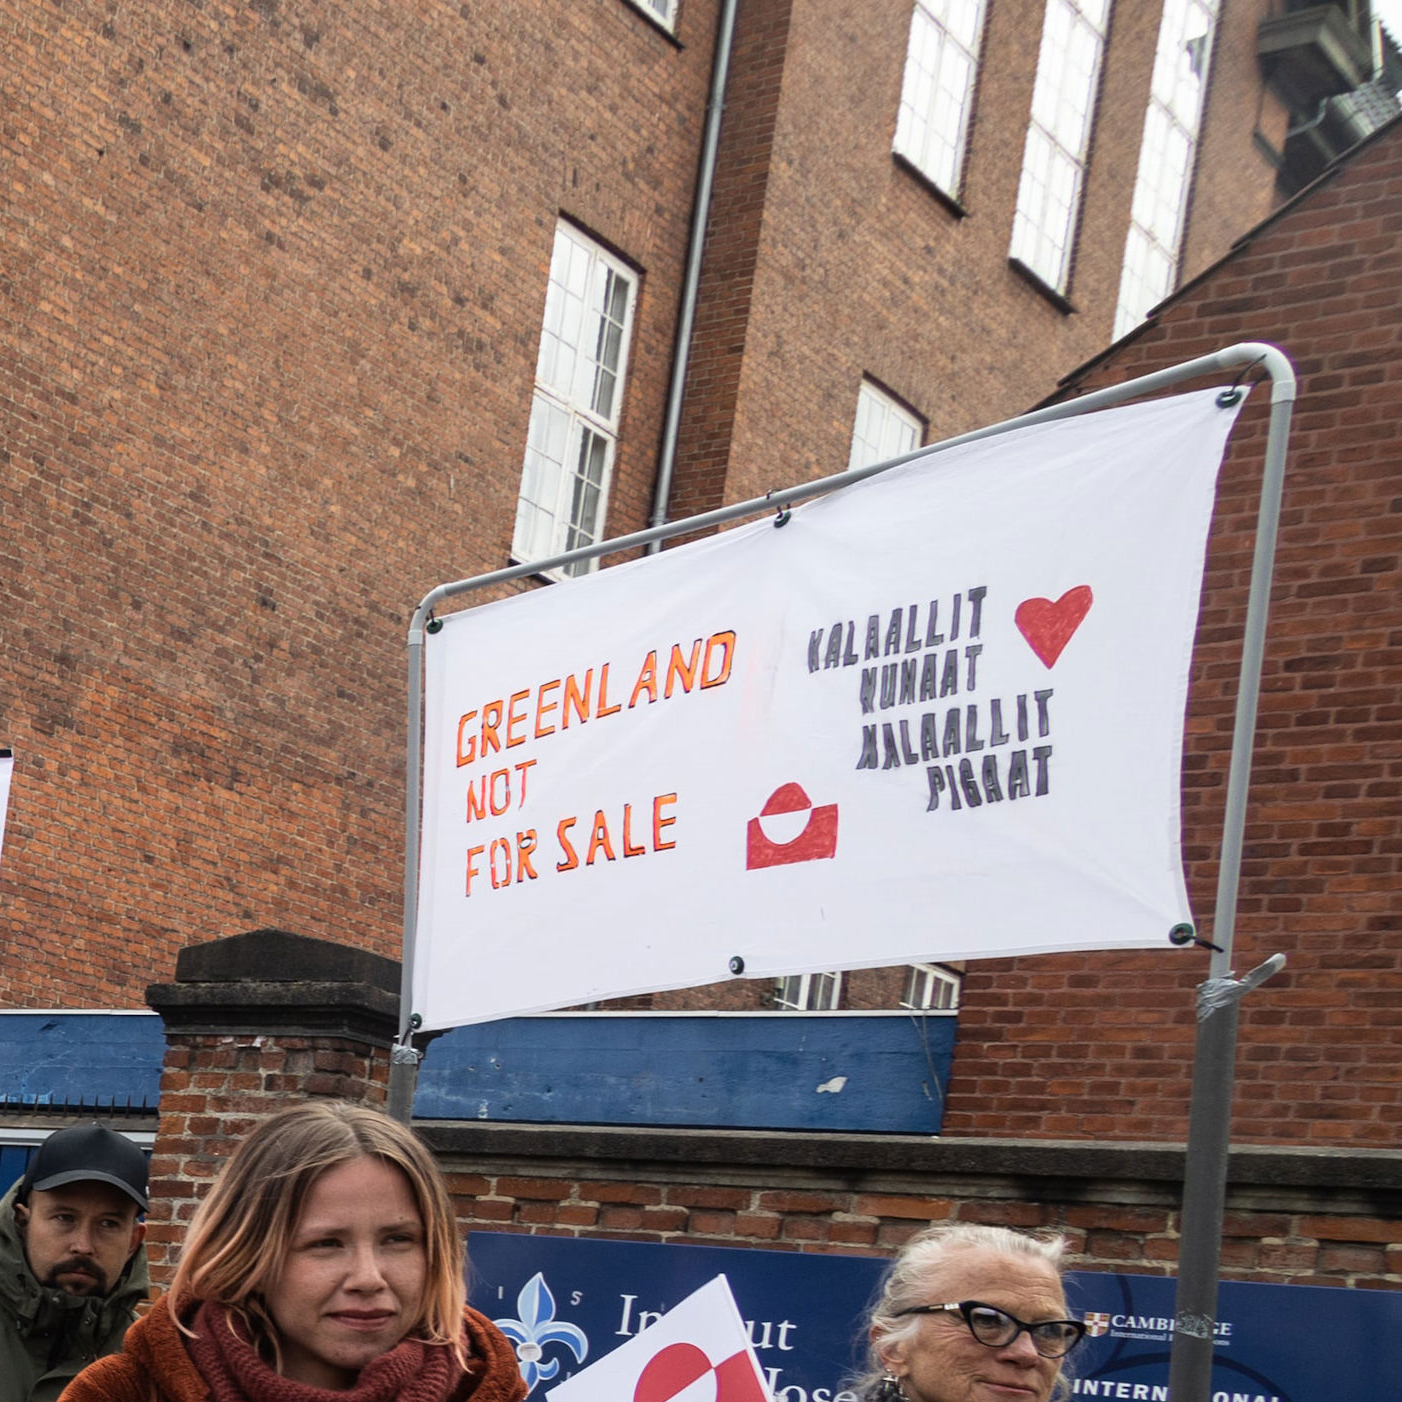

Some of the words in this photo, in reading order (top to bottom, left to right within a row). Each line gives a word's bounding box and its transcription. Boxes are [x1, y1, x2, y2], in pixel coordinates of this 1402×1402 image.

[807, 585, 987, 674] KALAALLIT
[455, 629, 738, 770] GREENLAND
[465, 758, 538, 825] NOT
[464, 831, 539, 900] FOR
[555, 791, 678, 875] SALE
